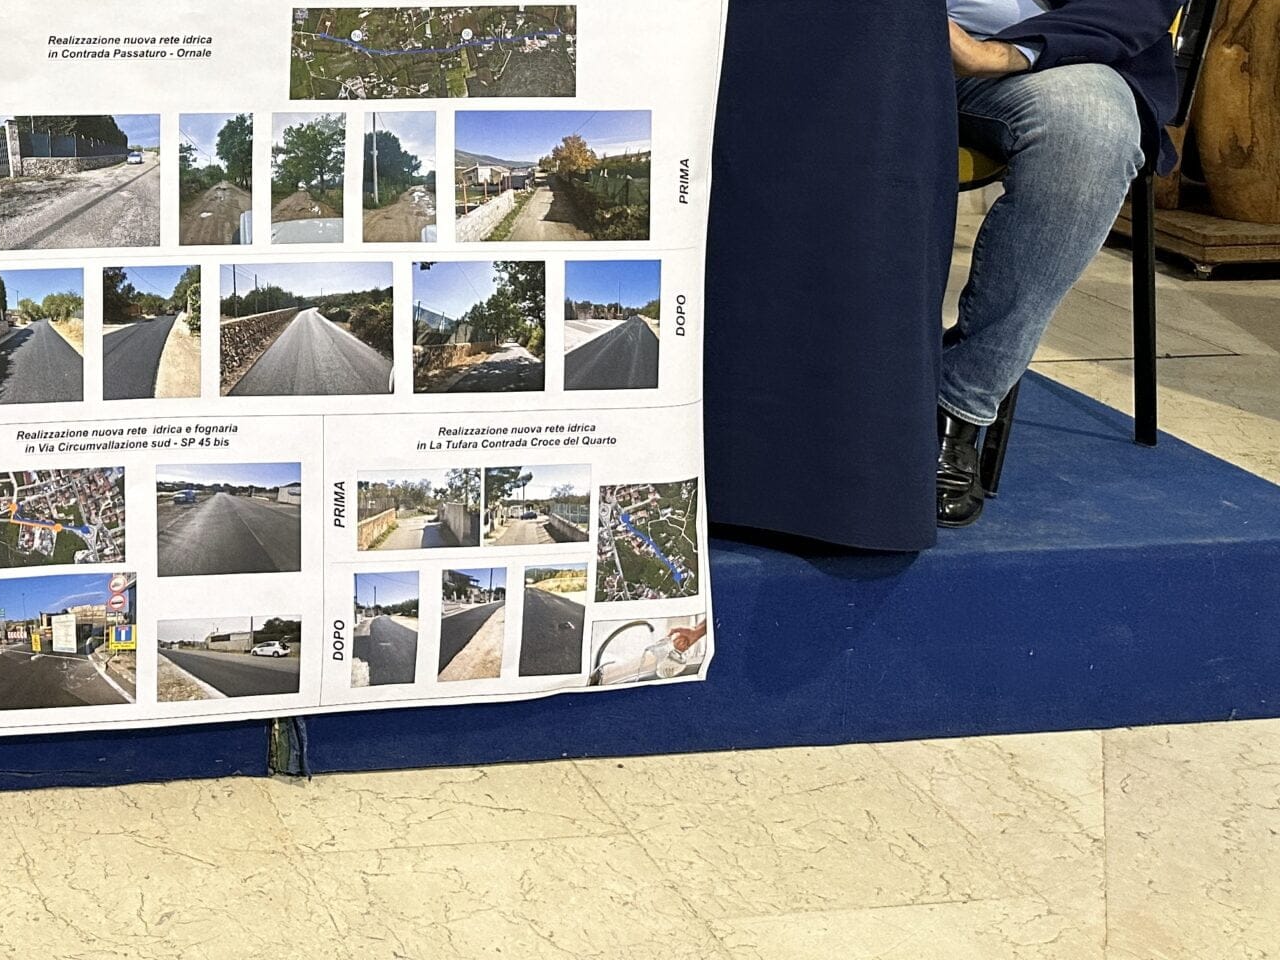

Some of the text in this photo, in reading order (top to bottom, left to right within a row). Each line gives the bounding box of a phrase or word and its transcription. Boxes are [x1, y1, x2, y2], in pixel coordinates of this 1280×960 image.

[48, 35, 120, 45] Realizzazione
[159, 36, 180, 44] rete
[182, 34, 212, 44] idrica
[48, 49, 58, 58] in
[61, 48, 110, 58] Contrada
[113, 48, 166, 58] Passaturo
[177, 48, 212, 58] Ornale
[679, 158, 690, 205] PRIMA
[676, 294, 686, 336] DOPO
[16, 430, 88, 440] Realizzazione
[92, 429, 124, 437] nuova
[127, 426, 147, 436] rete
[152, 425, 182, 435] idrica
[195, 424, 238, 435] fognaria
[438, 423, 596, 436] Realizzazione nuova rete idrica
[25, 444, 34, 453] in
[38, 443, 55, 453] Via
[58, 440, 148, 452] Circumvallazione
[151, 439, 170, 448] sud
[180, 438, 196, 447] SP
[199, 438, 211, 447] 45
[214, 437, 229, 446] bis
[417, 436, 616, 450] in La Tufara Contrada Croce del Quarto
[334, 481, 346, 528] PRIMA
[333, 620, 345, 661] DOPO
